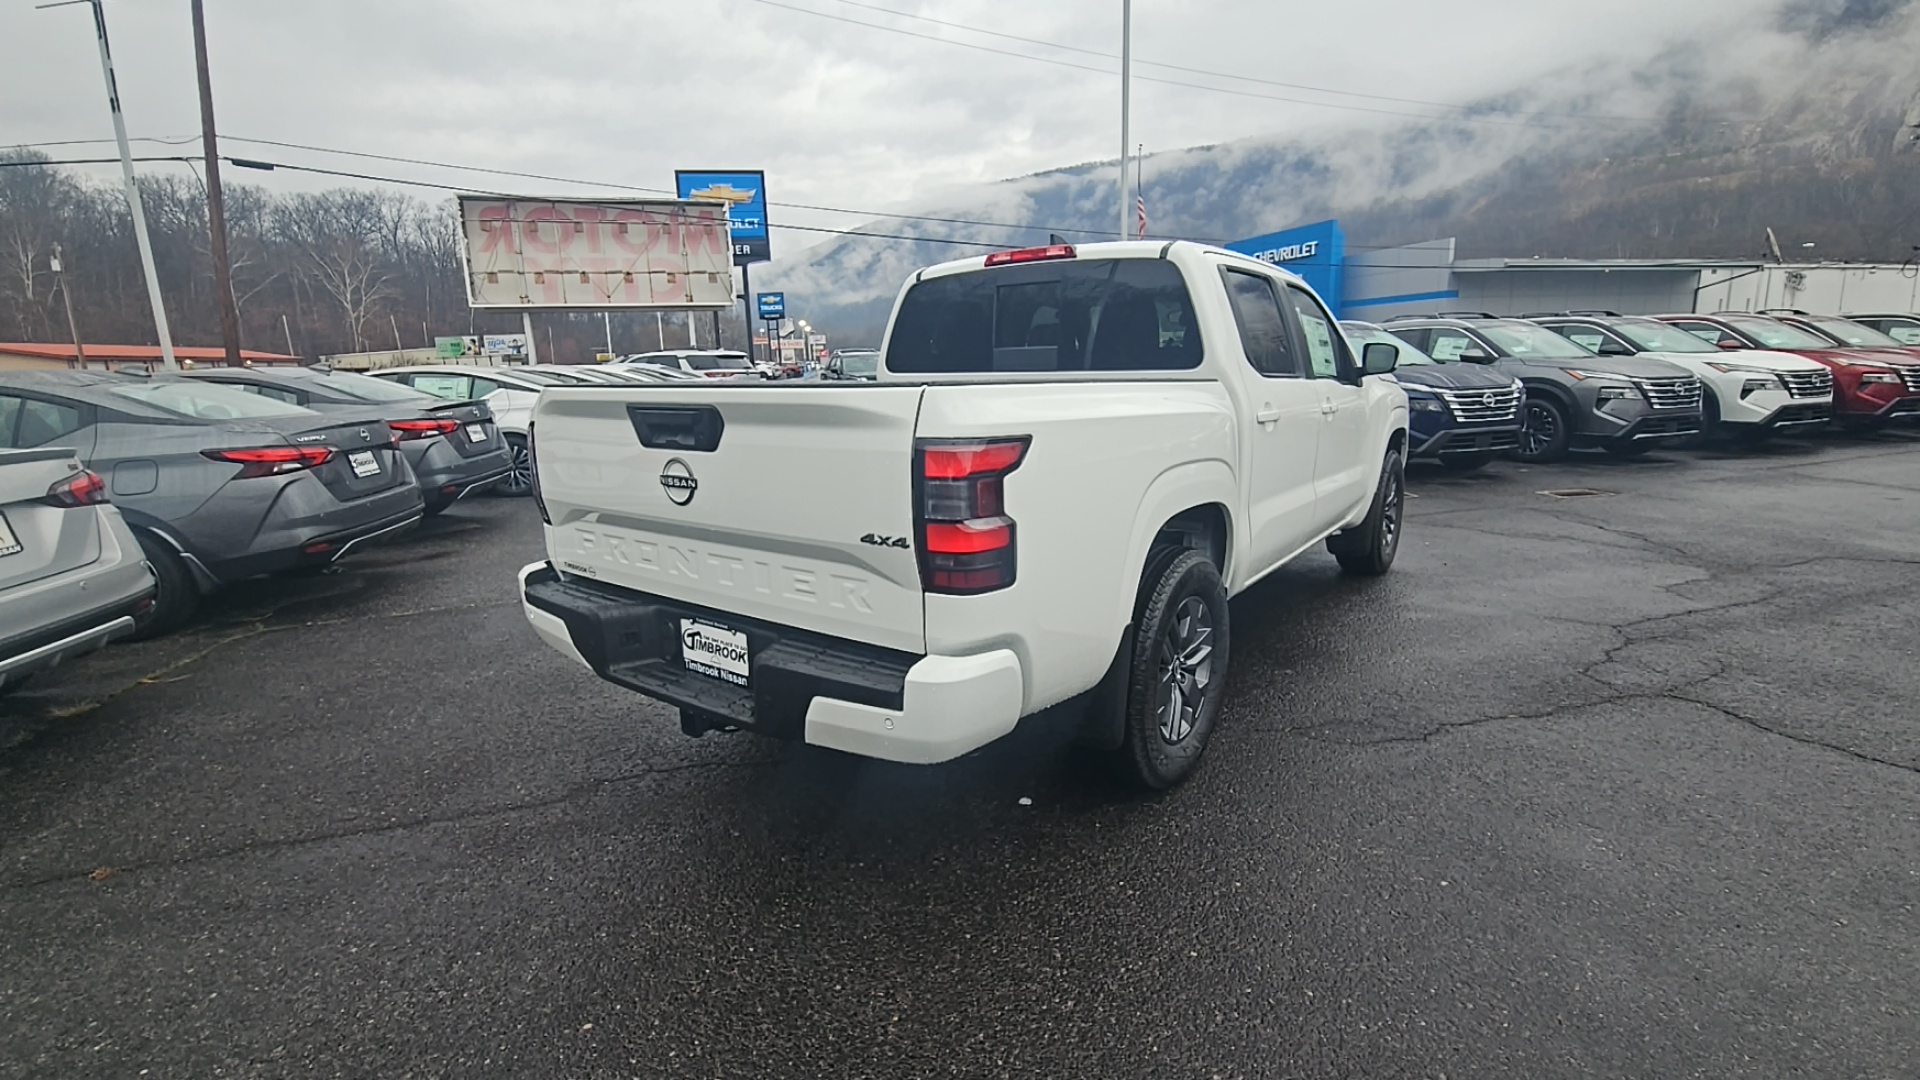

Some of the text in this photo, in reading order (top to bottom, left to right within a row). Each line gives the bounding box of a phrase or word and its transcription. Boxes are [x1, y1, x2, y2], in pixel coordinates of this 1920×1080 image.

[660, 476, 696, 488] NISSAN
[574, 528, 874, 614] FRONTIER
[683, 628, 747, 665] TIMBROOK
[684, 658, 748, 686] Timbrook Nissan
